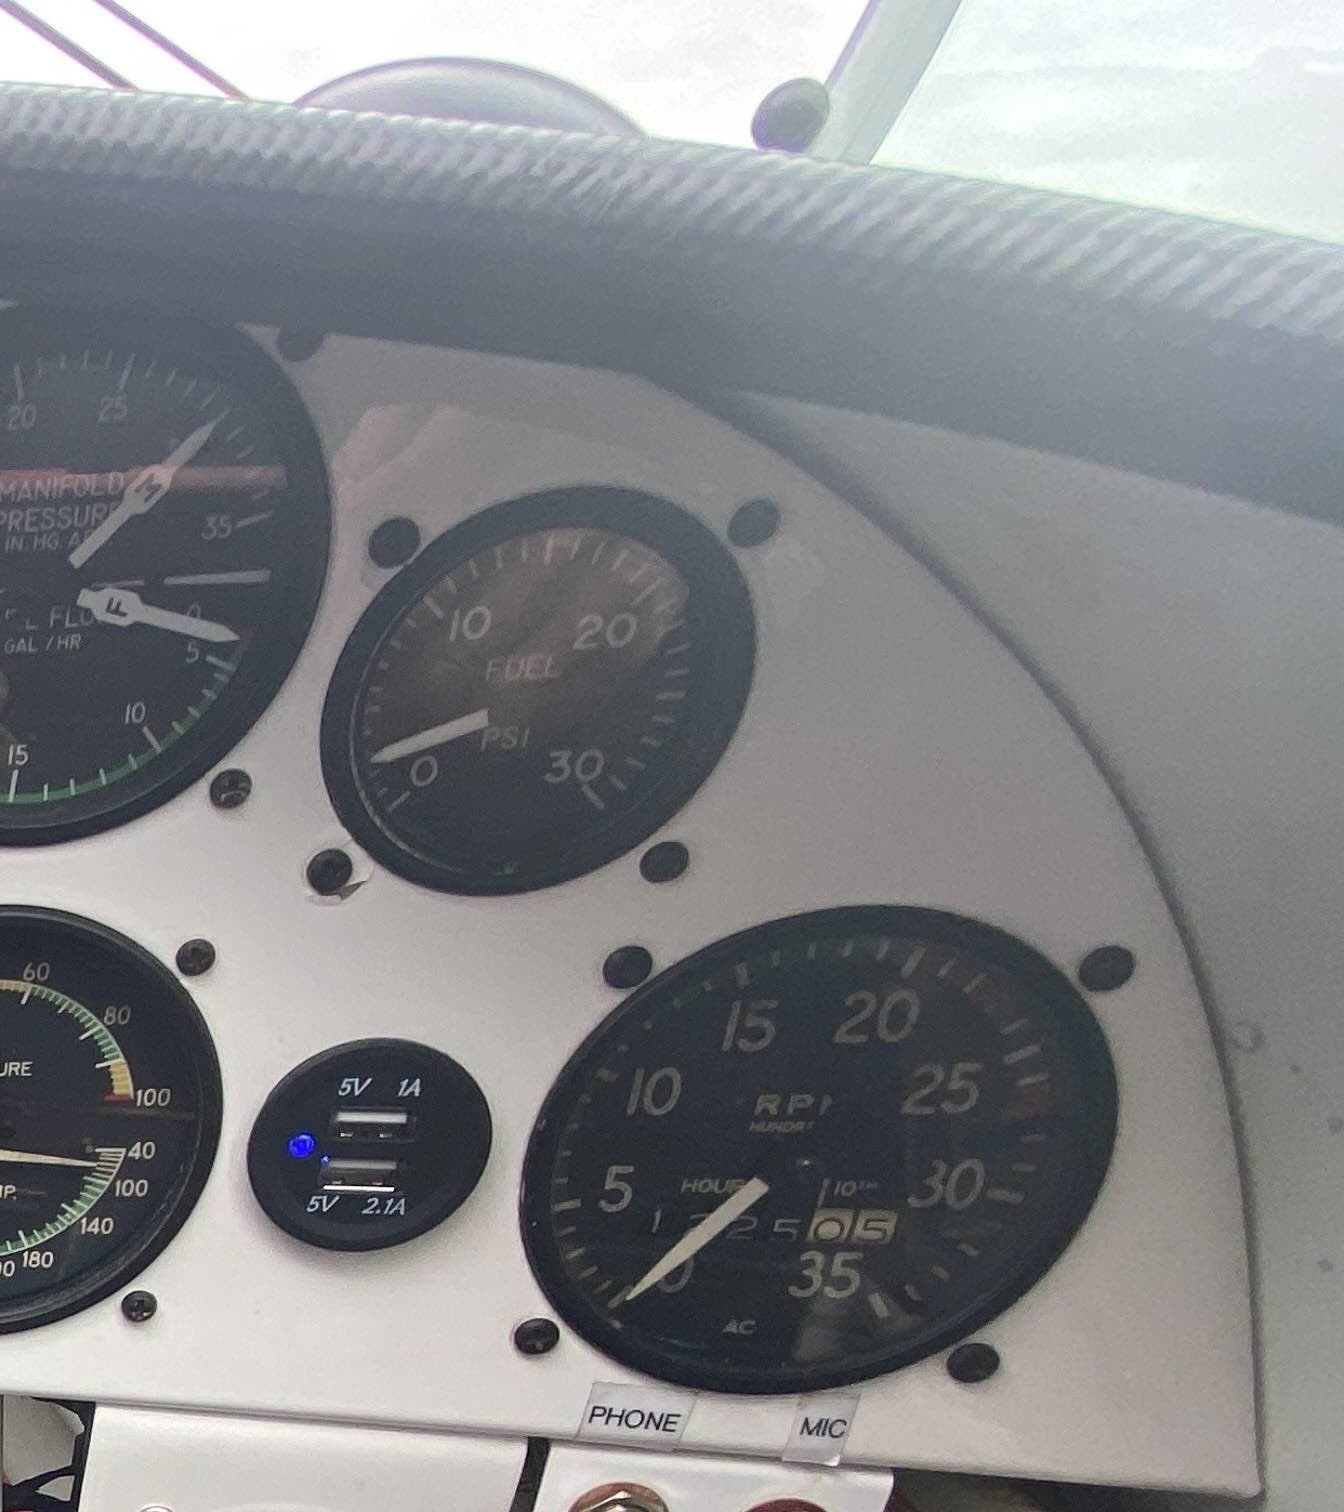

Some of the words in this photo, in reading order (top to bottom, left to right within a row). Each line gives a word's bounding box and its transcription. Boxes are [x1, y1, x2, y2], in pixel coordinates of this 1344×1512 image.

[450, 606, 492, 641] 10
[574, 614, 637, 651] 20
[485, 655, 560, 682] FUEL
[481, 727, 530, 750] PSI
[544, 748, 604, 783] 30
[23, 963, 50, 982] 60
[104, 1006, 131, 1025] 80
[721, 999, 778, 1052] 15
[832, 990, 921, 1044] 20
[136, 1088, 171, 1107] 100
[338, 1078, 372, 1096] 5V
[398, 1078, 421, 1097] 1A
[624, 1066, 682, 1116] 10
[900, 1062, 984, 1115] 25
[128, 1142, 155, 1160] 40
[114, 1180, 148, 1197] 100
[908, 1158, 986, 1209] 30
[306, 1196, 340, 1213] 5V
[362, 1198, 406, 1215] 2.1A
[80, 1217, 113, 1236] 140
[22, 1251, 53, 1269] 180
[588, 1406, 680, 1433] PHONE
[800, 1418, 847, 1438] MIC
